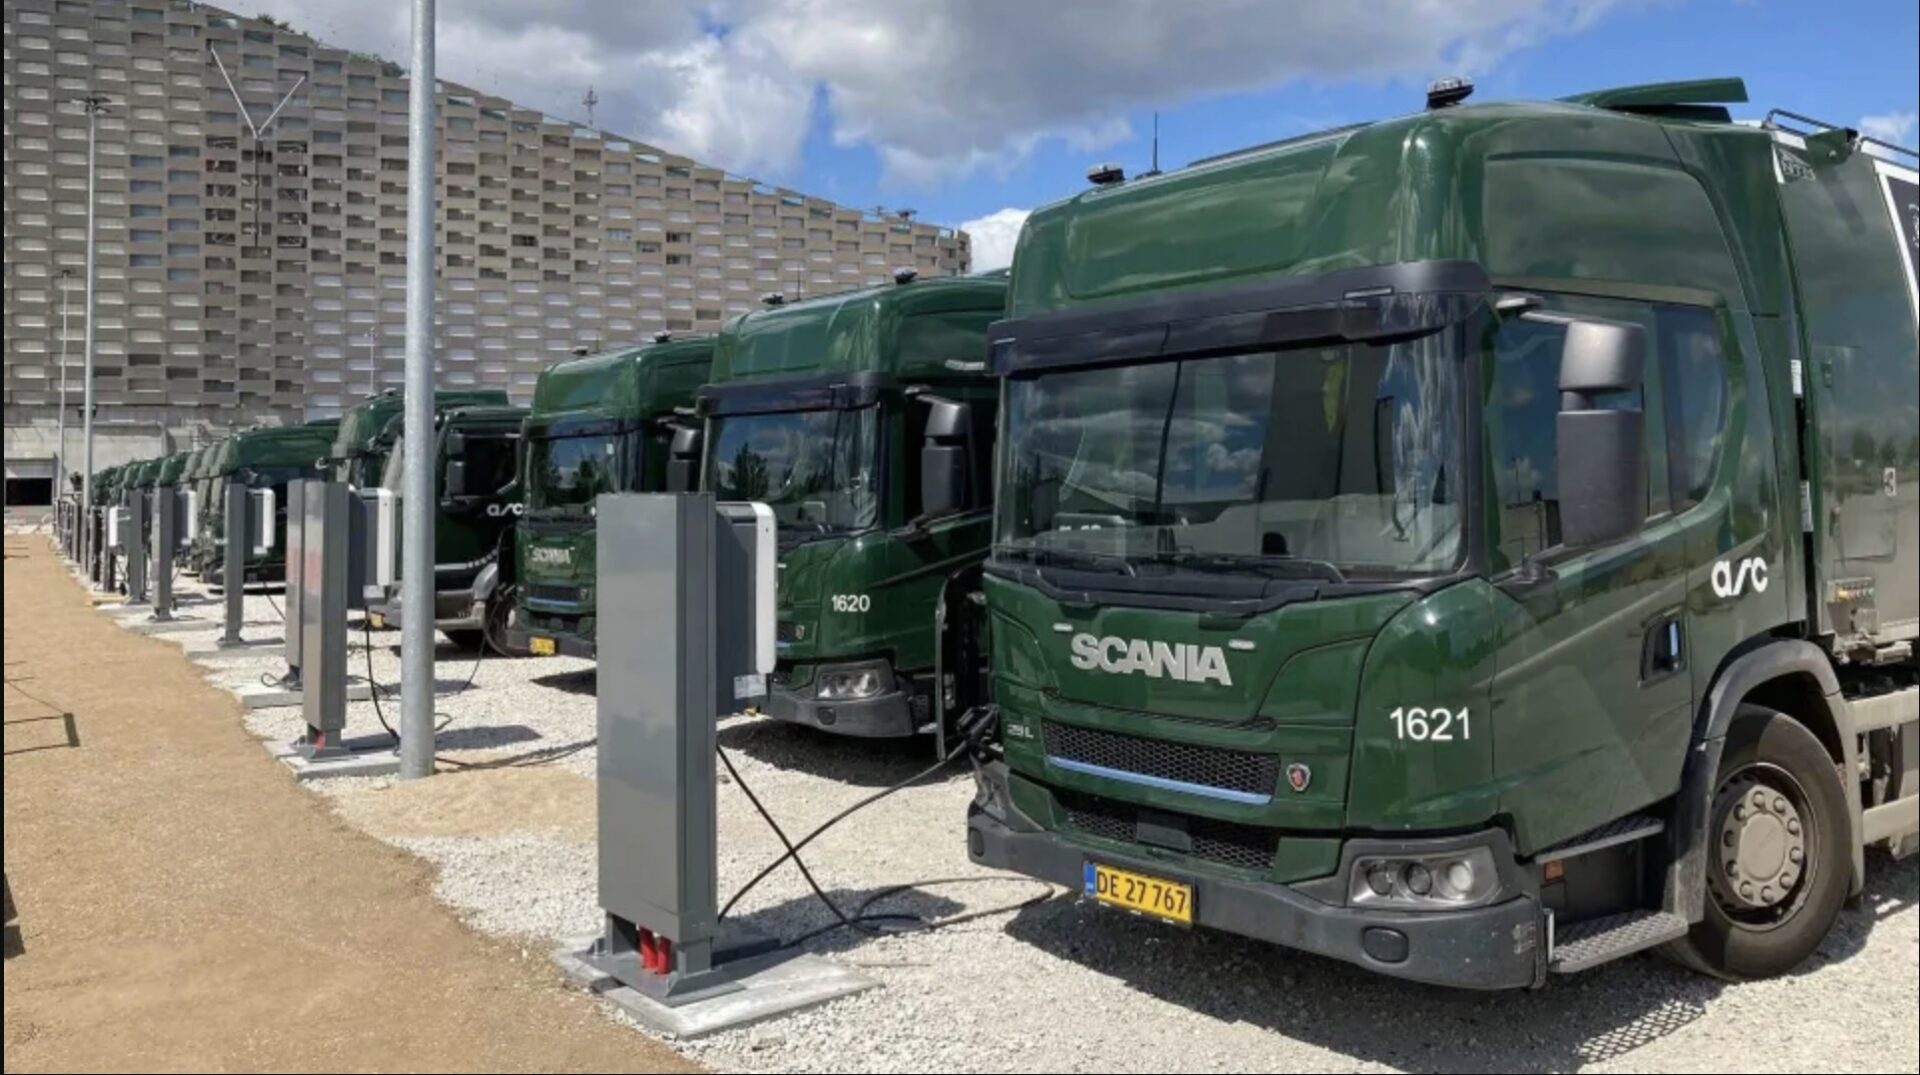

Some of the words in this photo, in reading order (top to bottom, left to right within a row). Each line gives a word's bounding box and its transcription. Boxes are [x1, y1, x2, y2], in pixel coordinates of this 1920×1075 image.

[831, 594, 871, 613] 1620
[1070, 632, 1233, 686] SCANIA
[1389, 706, 1471, 741] 1621
[1097, 871, 1119, 898] DE
[1125, 877, 1147, 904] 27
[1153, 884, 1186, 914] 767
